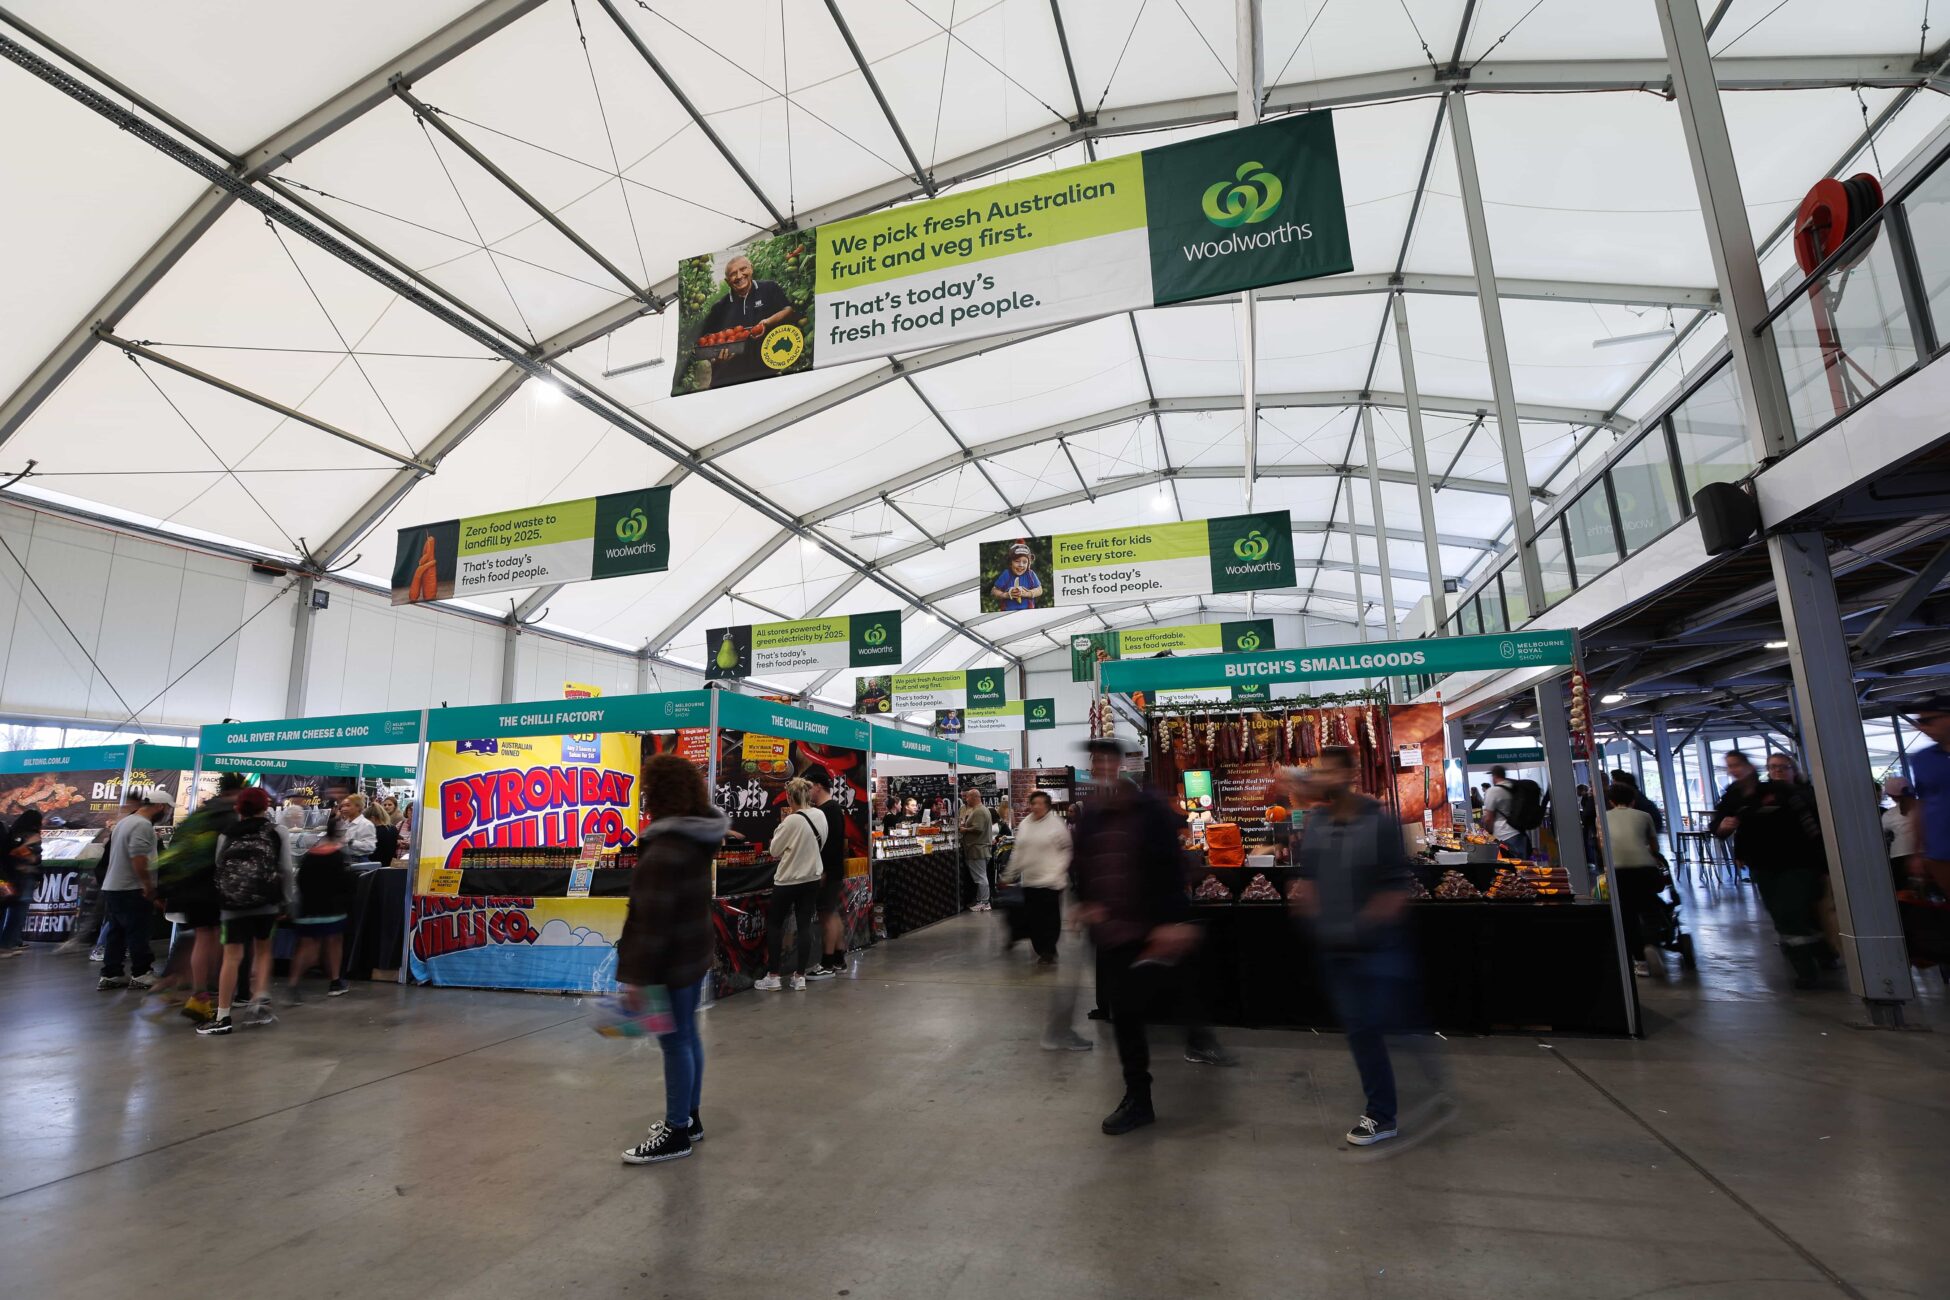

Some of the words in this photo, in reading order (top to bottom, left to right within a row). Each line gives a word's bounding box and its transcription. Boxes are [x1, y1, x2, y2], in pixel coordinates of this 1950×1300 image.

[831, 233, 868, 256] We
[873, 222, 918, 252] pick
[923, 207, 981, 238] fresh
[986, 178, 1116, 221] Australian
[1183, 219, 1313, 263] Woolworths
[830, 252, 877, 280] fruit
[881, 242, 926, 270] and
[931, 237, 973, 265] veg
[979, 222, 1033, 251] first.
[829, 291, 901, 321] That's
[905, 272, 995, 314] today's
[829, 316, 886, 345] fresh
[891, 306, 946, 334] food
[950, 289, 1041, 330] people.
[466, 525, 487, 537] Zero
[489, 520, 512, 534] food
[514, 517, 544, 530] waste
[546, 514, 557, 525] to
[464, 535, 498, 550] landfill
[500, 534, 512, 547] by
[514, 529, 542, 542] 2025.
[1060, 541, 1083, 552] Free
[1085, 538, 1109, 550] fruit
[1111, 536, 1127, 547] for
[1129, 534, 1152, 546] kids
[606, 541, 656, 559] Woolworths
[1060, 554, 1070, 564] in
[1072, 551, 1102, 565] every
[1104, 548, 1137, 561] store.
[463, 560, 493, 572] That's
[495, 554, 532, 571] today's
[1225, 561, 1281, 576] Woolworths
[462, 574, 485, 586] fresh
[488, 570, 510, 583] food
[512, 565, 549, 582] people.
[1061, 571, 1096, 585] That's
[1099, 568, 1141, 584] today's
[1061, 585, 1090, 597] fresh
[1092, 581, 1119, 594] food
[1120, 578, 1163, 594] people.
[756, 629, 766, 637] All
[767, 628, 789, 636] stores
[790, 624, 821, 635] powered
[823, 623, 832, 633] by
[756, 638, 777, 647] green
[778, 634, 812, 645] electricity
[813, 632, 823, 642] by
[824, 630, 845, 639] 2025.
[1124, 634, 1143, 642] More
[1145, 631, 1185, 641] affordable.
[858, 646, 893, 655] Woolworths
[1125, 643, 1141, 651] Less
[1161, 640, 1186, 649] waste.
[1517, 640, 1565, 649] MELBOURNE
[1518, 647, 1543, 655] ROYAL
[756, 651, 778, 660] That's
[780, 649, 806, 660] today's
[756, 661, 774, 669] fresh
[775, 659, 792, 667] food
[793, 657, 819, 668] people.
[1225, 660, 1296, 677] BUTCH'S
[1300, 651, 1426, 673] SMALLGOODS
[499, 716, 518, 727] THE
[520, 713, 553, 726] CHILLI
[555, 710, 605, 724] FACTORY
[772, 715, 784, 727] THE
[784, 718, 804, 731] CHILLI
[804, 722, 830, 735] FACTORY
[227, 733, 248, 744] COAL
[250, 731, 275, 743] RIVER
[276, 730, 300, 741] FARM
[302, 728, 335, 739] CHEESE
[336, 727, 343, 737] &
[344, 725, 369, 736] CHOC
[501, 741, 533, 751] AUSTRALIAN
[501, 749, 520, 758] OWNED
[23, 757, 70, 766] BILTONG.COM.AU
[215, 757, 287, 768] BILTONG.COM.AU
[92, 782, 166, 800] BILONG
[440, 766, 579, 839] BYRON
[580, 767, 634, 807] BAY
[489, 910, 540, 945] CO.
